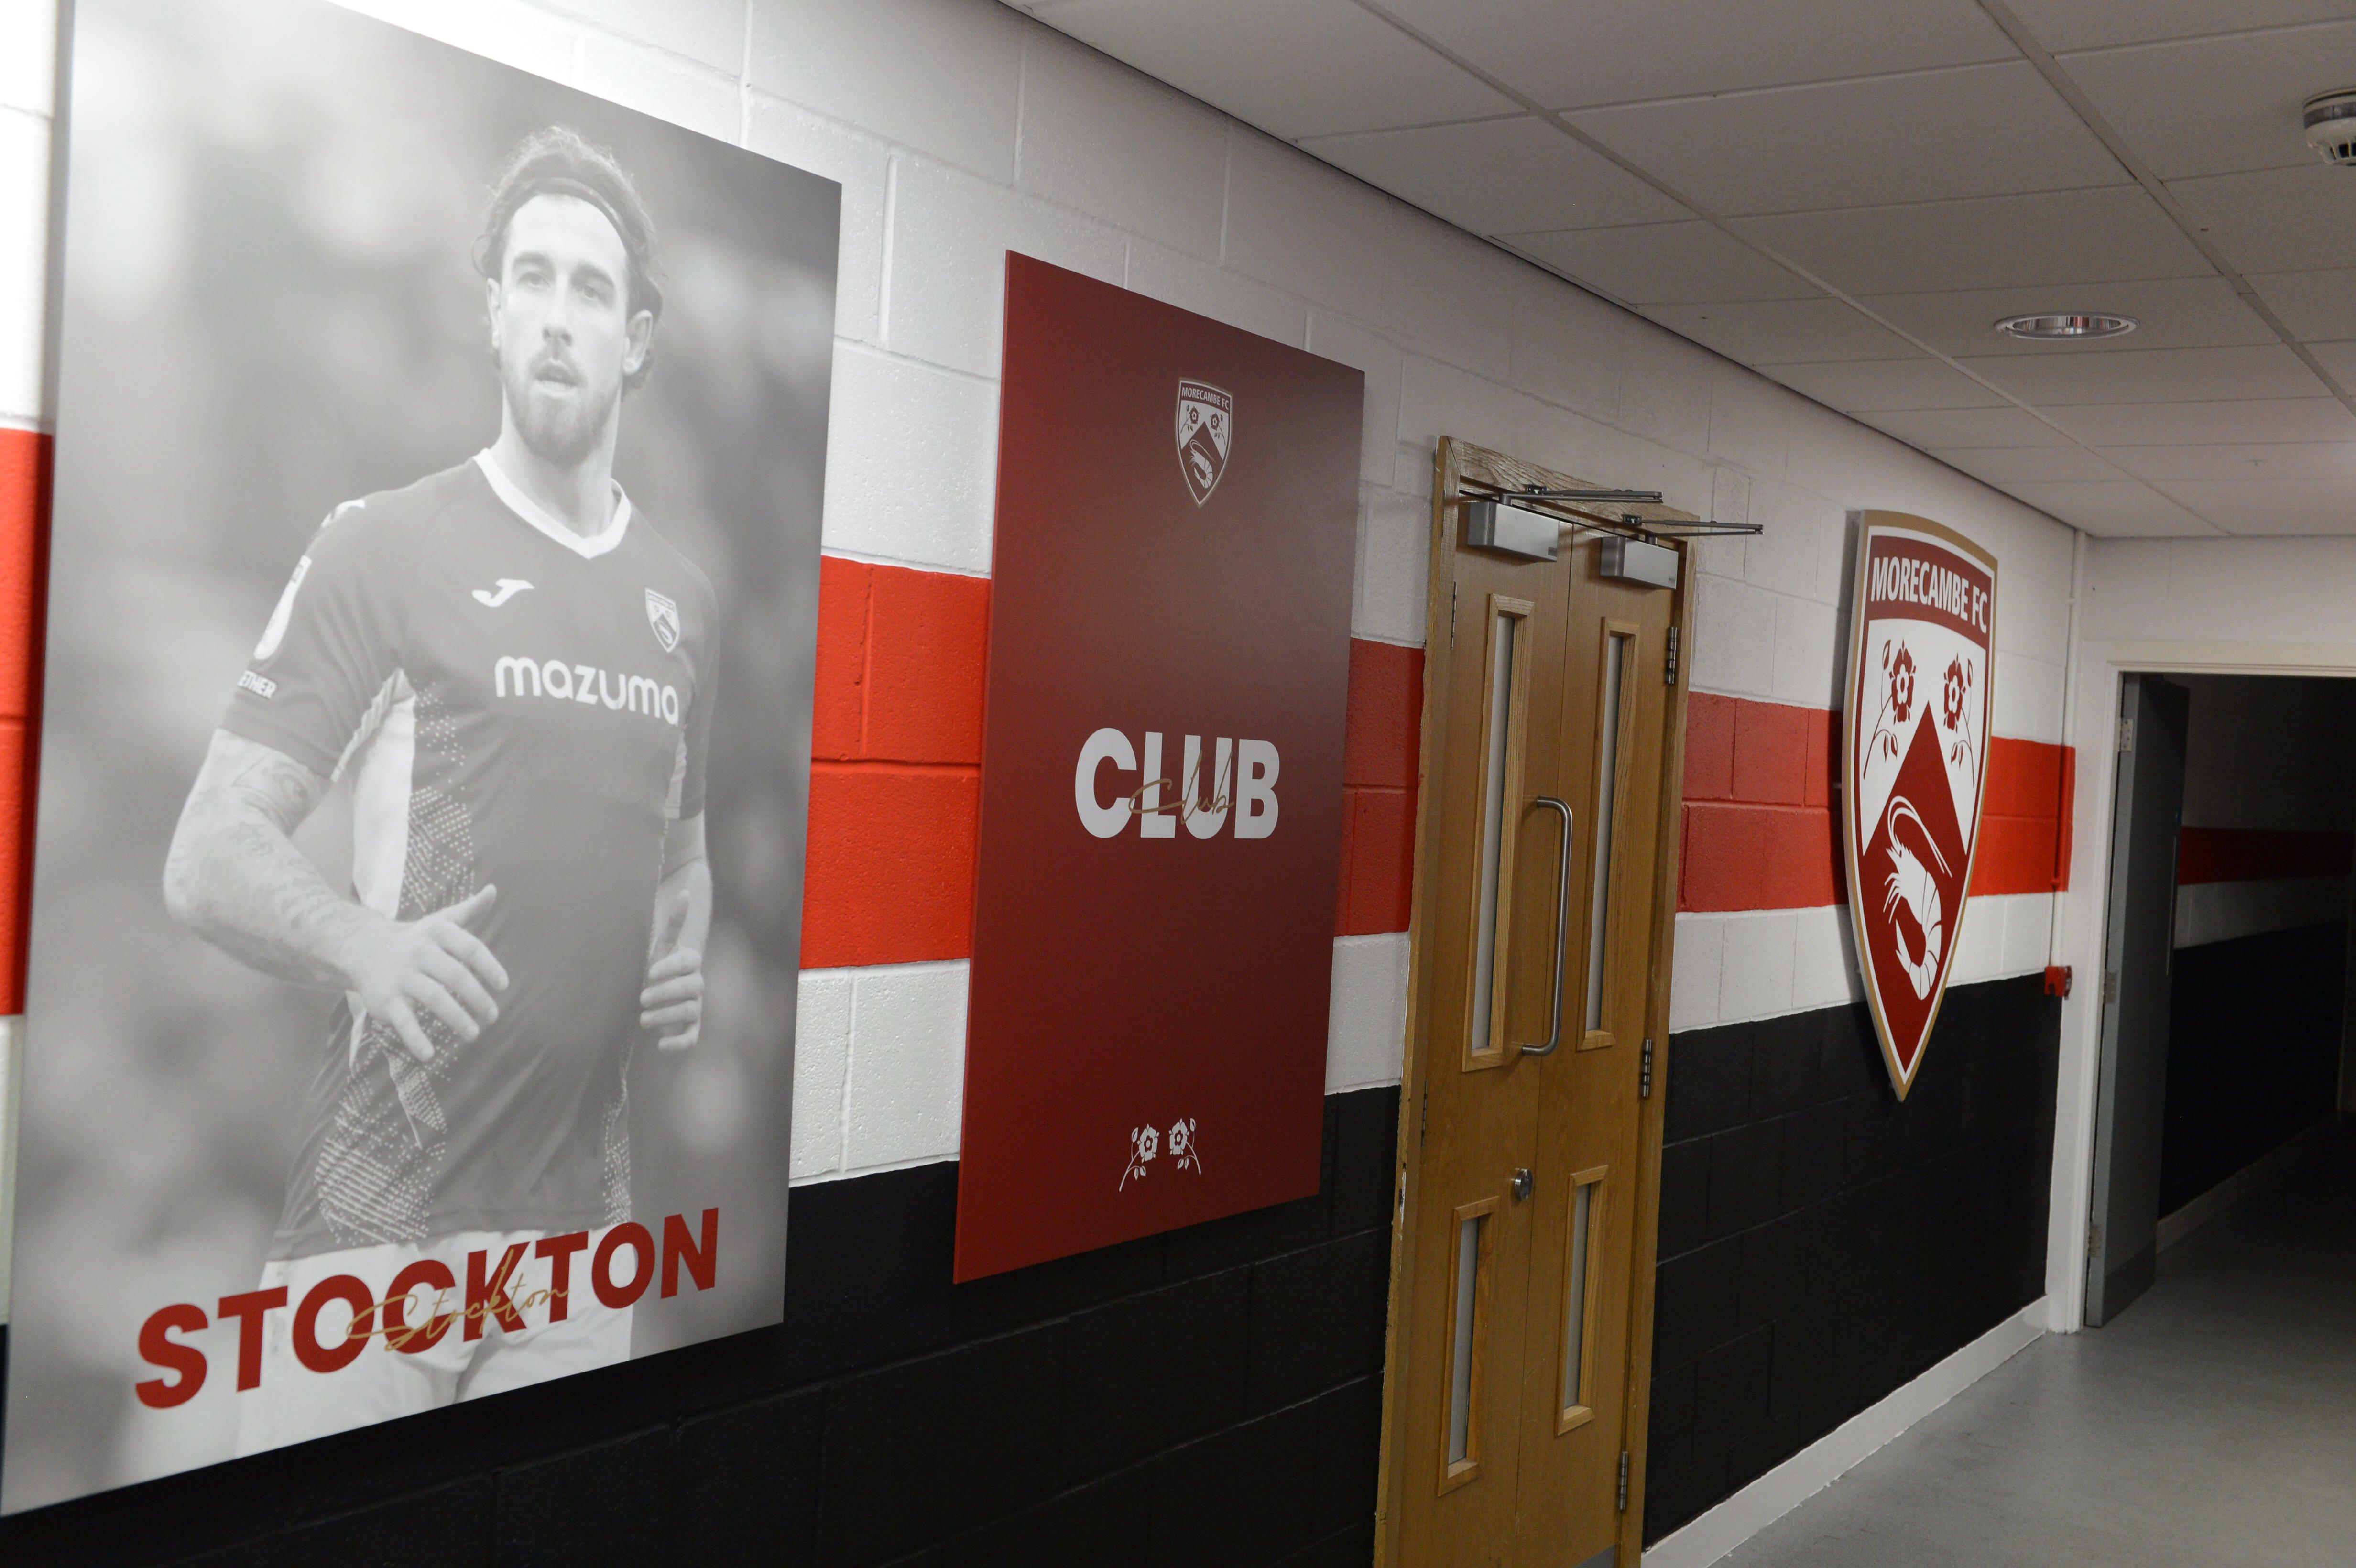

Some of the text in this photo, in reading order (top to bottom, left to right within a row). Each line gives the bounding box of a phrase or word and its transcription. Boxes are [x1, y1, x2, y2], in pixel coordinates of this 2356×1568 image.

[1182, 387, 1229, 410] MORECAMBE FC
[1871, 556, 1987, 633] MORECAMBE FC
[495, 656, 678, 726] mazuma
[1075, 728, 1279, 839] CLUB
[1129, 750, 1234, 824] Club
[135, 1208, 718, 1409] STOCKTON
[346, 1249, 569, 1351] Stockton
